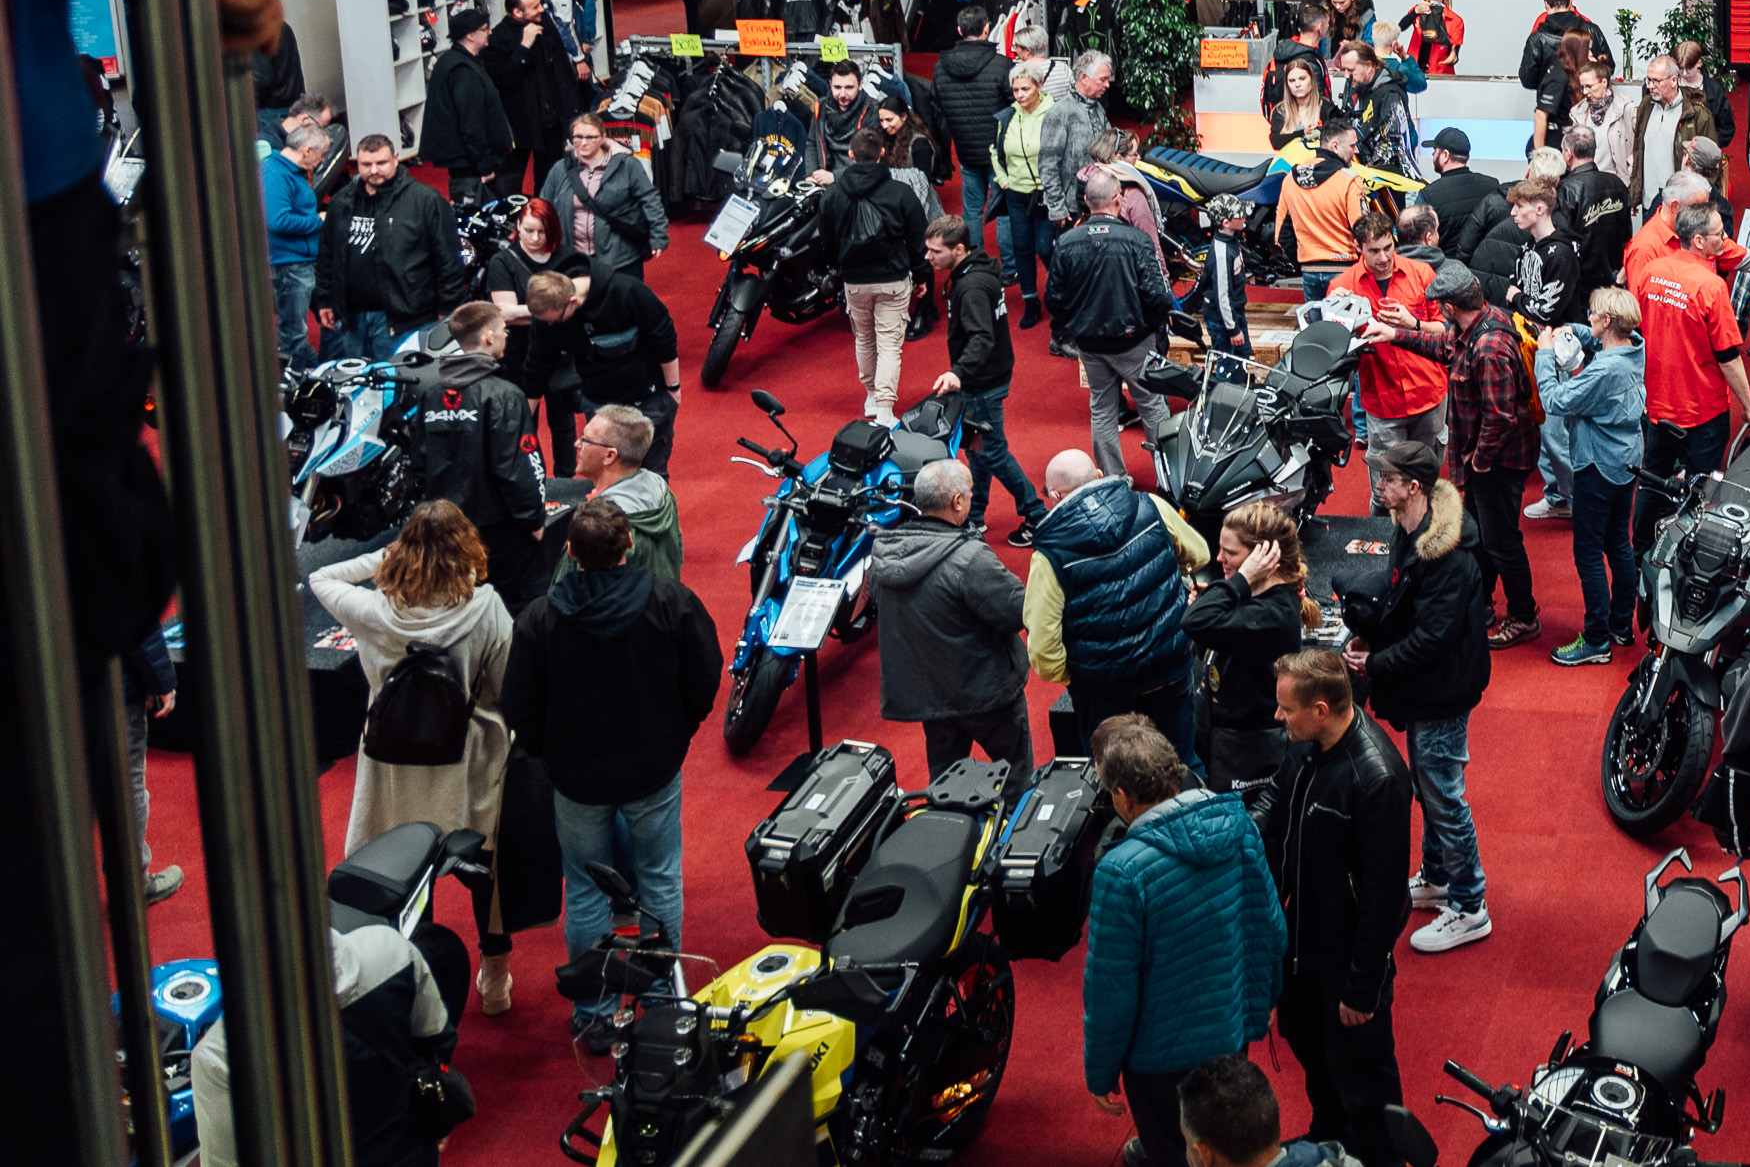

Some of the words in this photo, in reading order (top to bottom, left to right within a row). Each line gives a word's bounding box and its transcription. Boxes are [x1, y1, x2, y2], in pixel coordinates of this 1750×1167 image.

[675, 39, 699, 52] 50%
[823, 42, 846, 56] 50%
[1231, 777, 1271, 790] Kawasa
[811, 1041, 830, 1072] UKI
